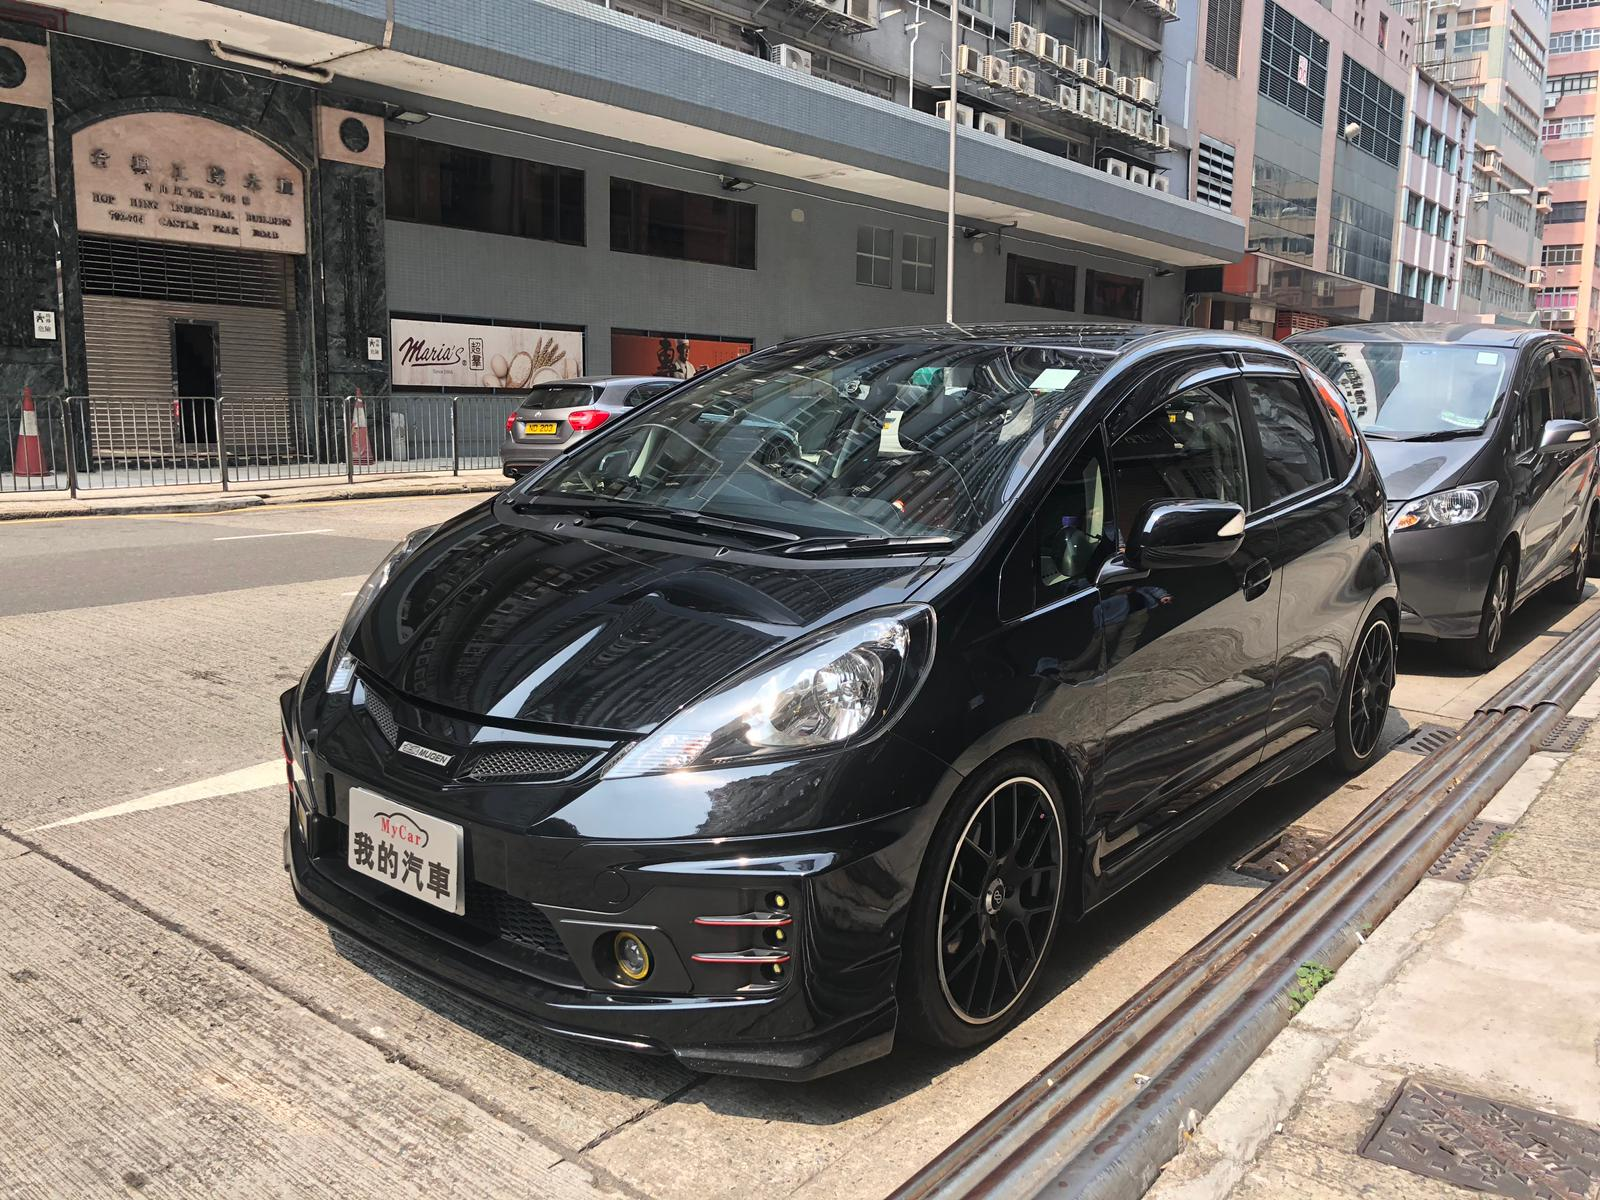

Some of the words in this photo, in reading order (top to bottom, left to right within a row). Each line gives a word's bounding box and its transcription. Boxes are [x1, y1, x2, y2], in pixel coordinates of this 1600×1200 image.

[92, 192, 116, 205] HOP
[130, 198, 159, 210] HING
[170, 201, 235, 220] INDUSTRIAL
[245, 212, 292, 227] BUILDING
[159, 217, 200, 230] CASTLE
[212, 225, 239, 236] PEAK
[252, 229, 279, 239] ROAD
[399, 337, 464, 367] Maria's
[419, 749, 448, 764] MUGEN
[381, 817, 422, 846] MyCar
[353, 832, 451, 899] 我的汽車
